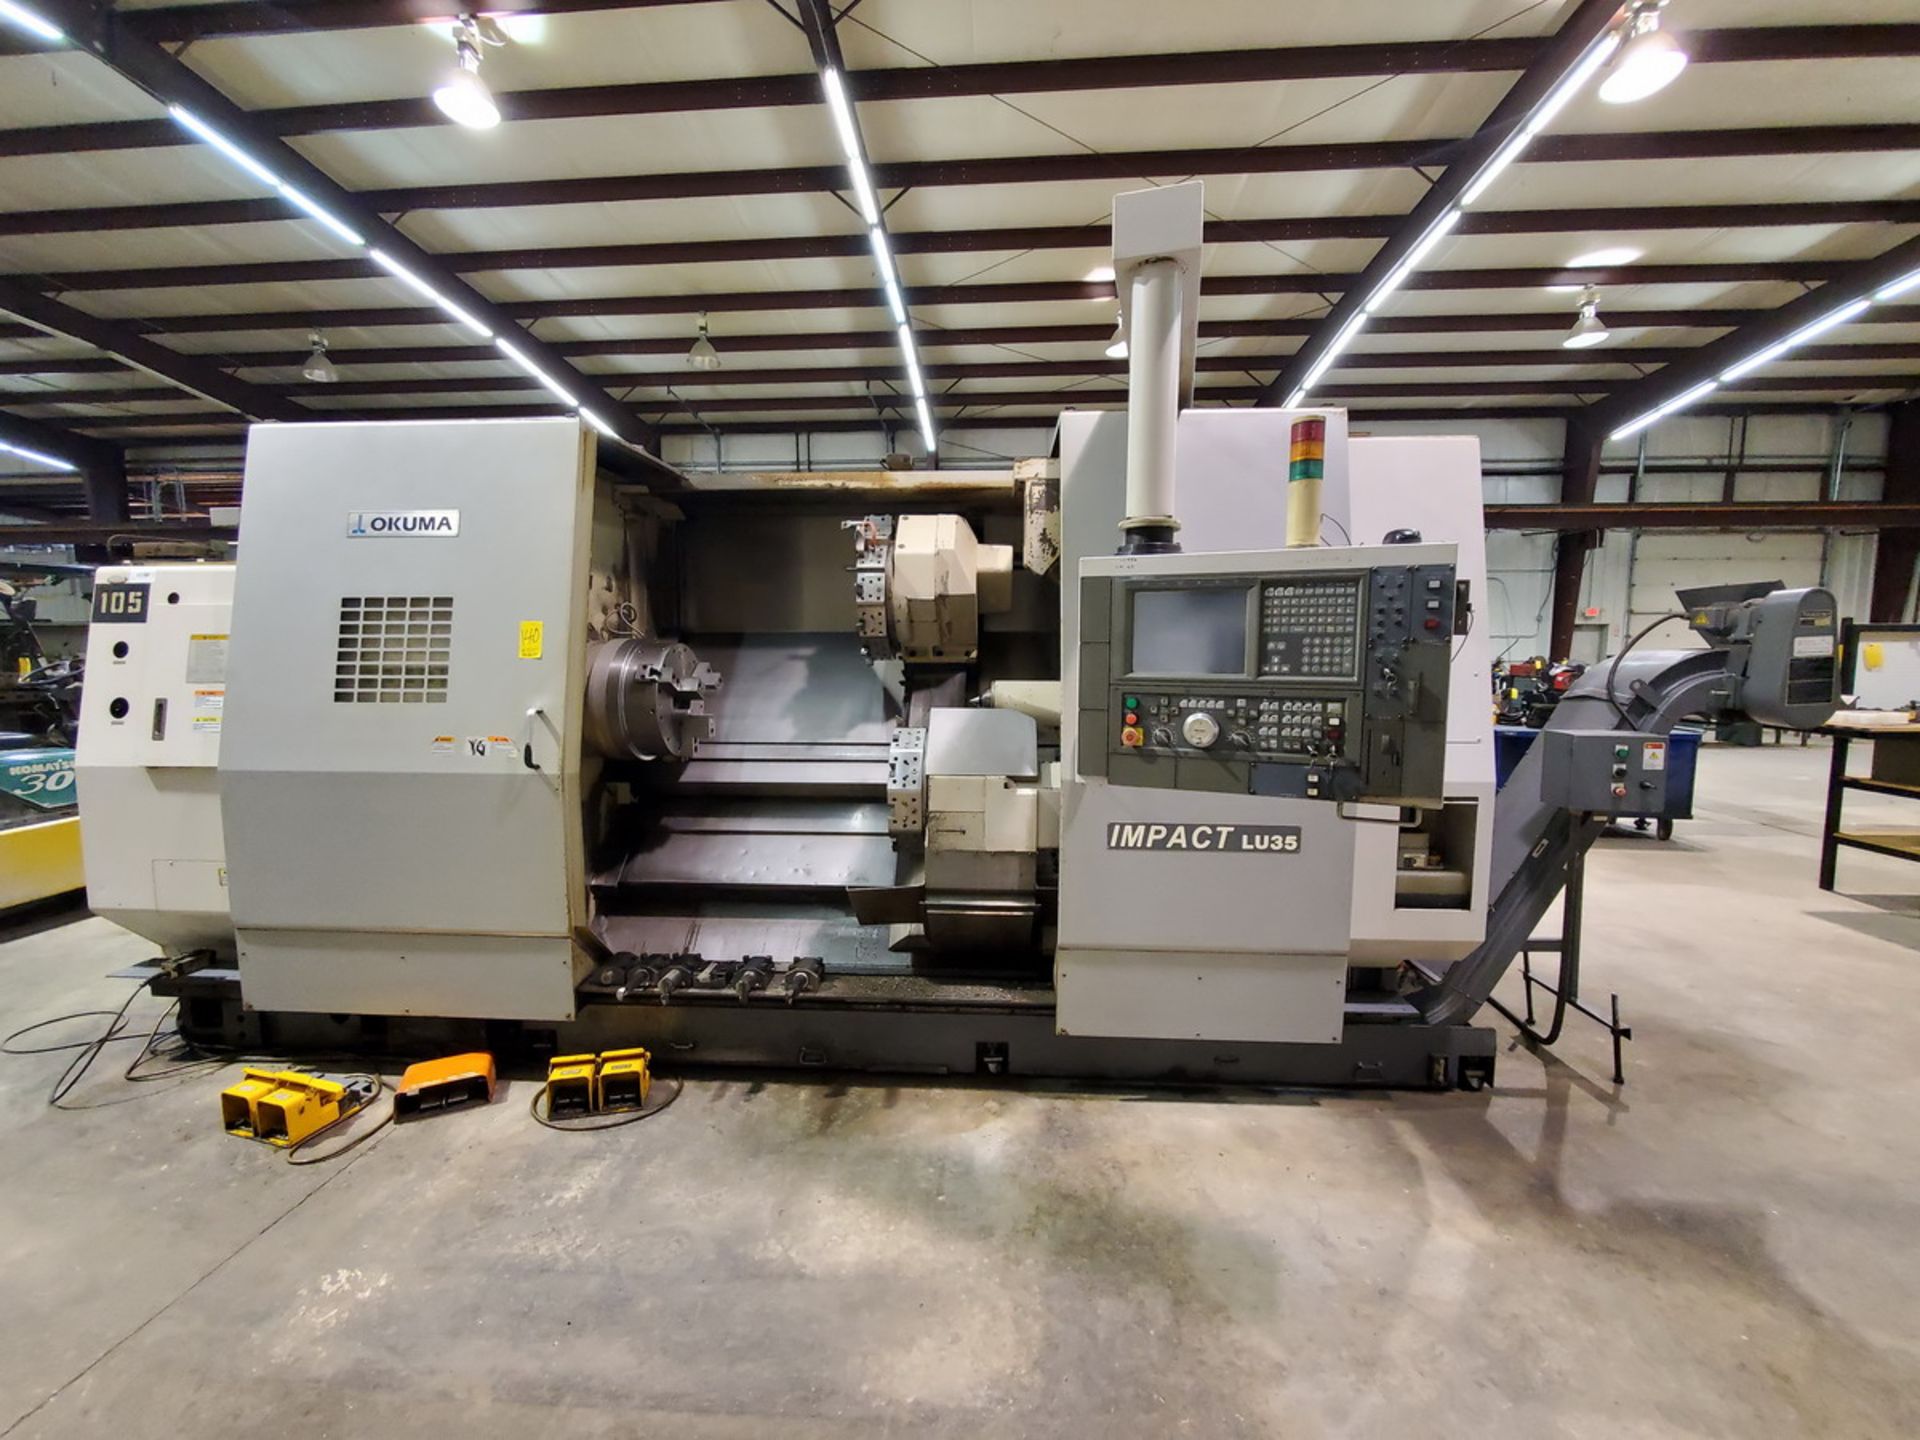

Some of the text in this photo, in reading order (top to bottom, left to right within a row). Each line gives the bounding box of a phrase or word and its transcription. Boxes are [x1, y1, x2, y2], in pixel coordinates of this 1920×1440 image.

[370, 516, 453, 532] OKUMA
[100, 591, 144, 614] 105
[13, 769, 75, 795] 30
[1110, 824, 1298, 851] IMPACT LU35
